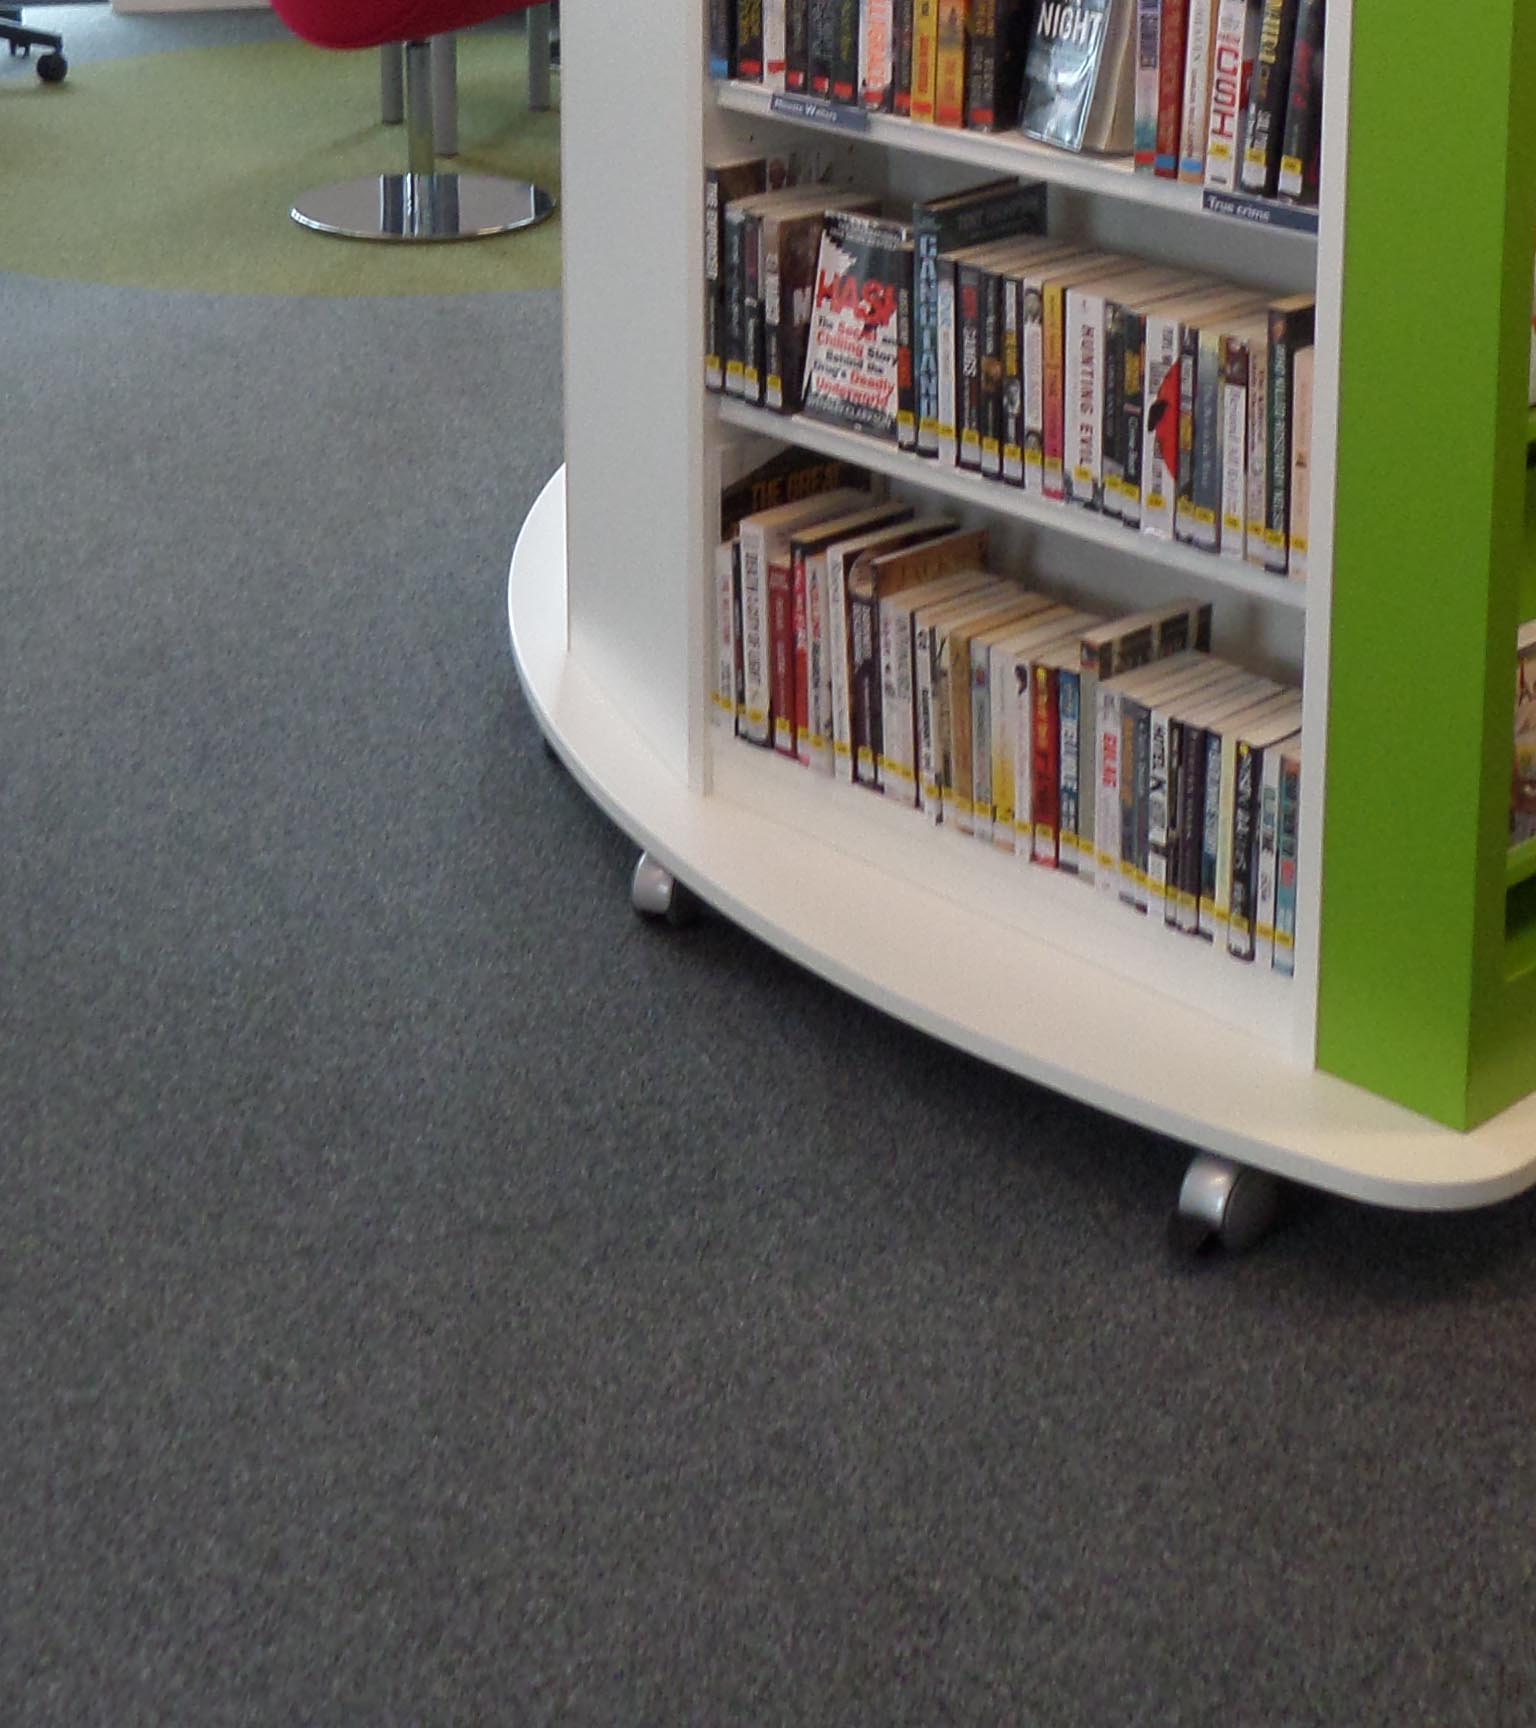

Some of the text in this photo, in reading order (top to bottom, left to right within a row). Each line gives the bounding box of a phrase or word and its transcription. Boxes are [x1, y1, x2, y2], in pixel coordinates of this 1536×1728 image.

[1037, 1, 1104, 45] NIGHT
[1140, 13, 1158, 70] SUMMER
[1207, 195, 1271, 223] True crime
[706, 210, 718, 281] ENFORCER
[816, 330, 898, 367] Chilling Story
[826, 349, 884, 374] Behind the
[817, 376, 890, 409] Underworld
[850, 369, 896, 397] Deadly
[1078, 324, 1096, 466] HUNTING EVIL
